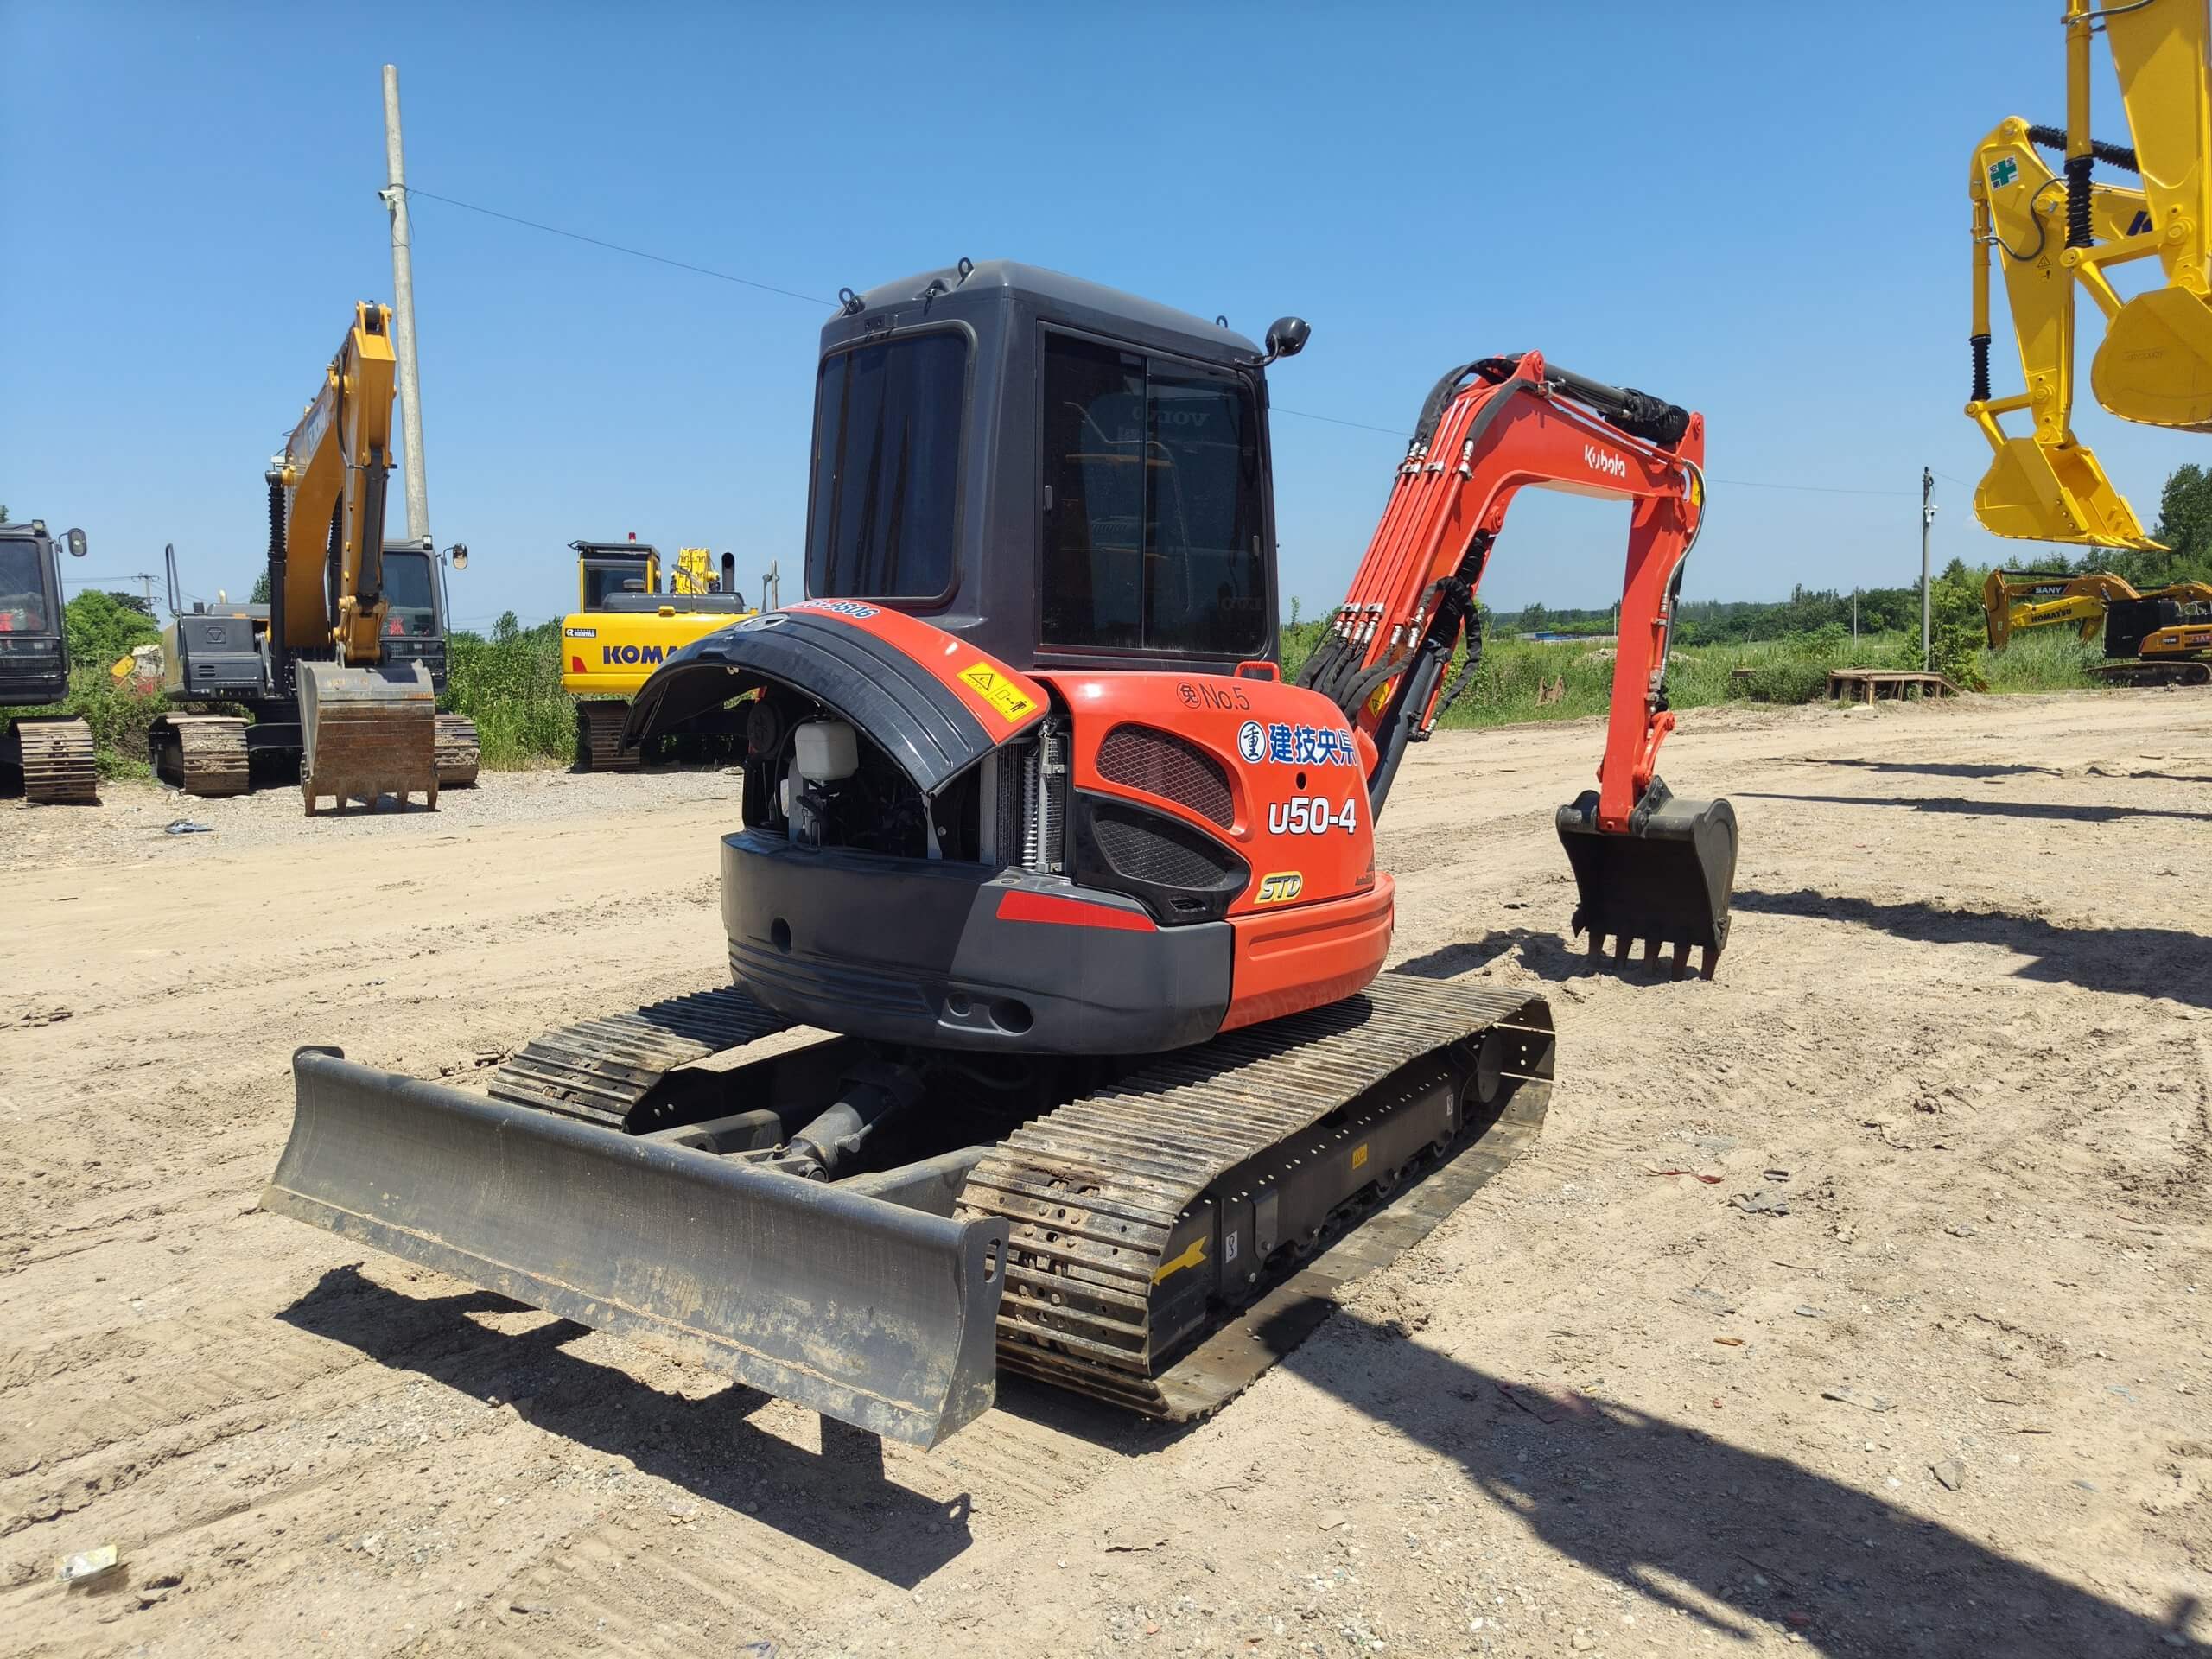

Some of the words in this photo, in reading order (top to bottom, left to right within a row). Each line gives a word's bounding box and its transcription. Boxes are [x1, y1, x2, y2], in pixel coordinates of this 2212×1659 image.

[1584, 444, 1625, 478] Kubota
[2032, 608, 2071, 622] KOMATSU
[1259, 874, 1301, 900] STD
